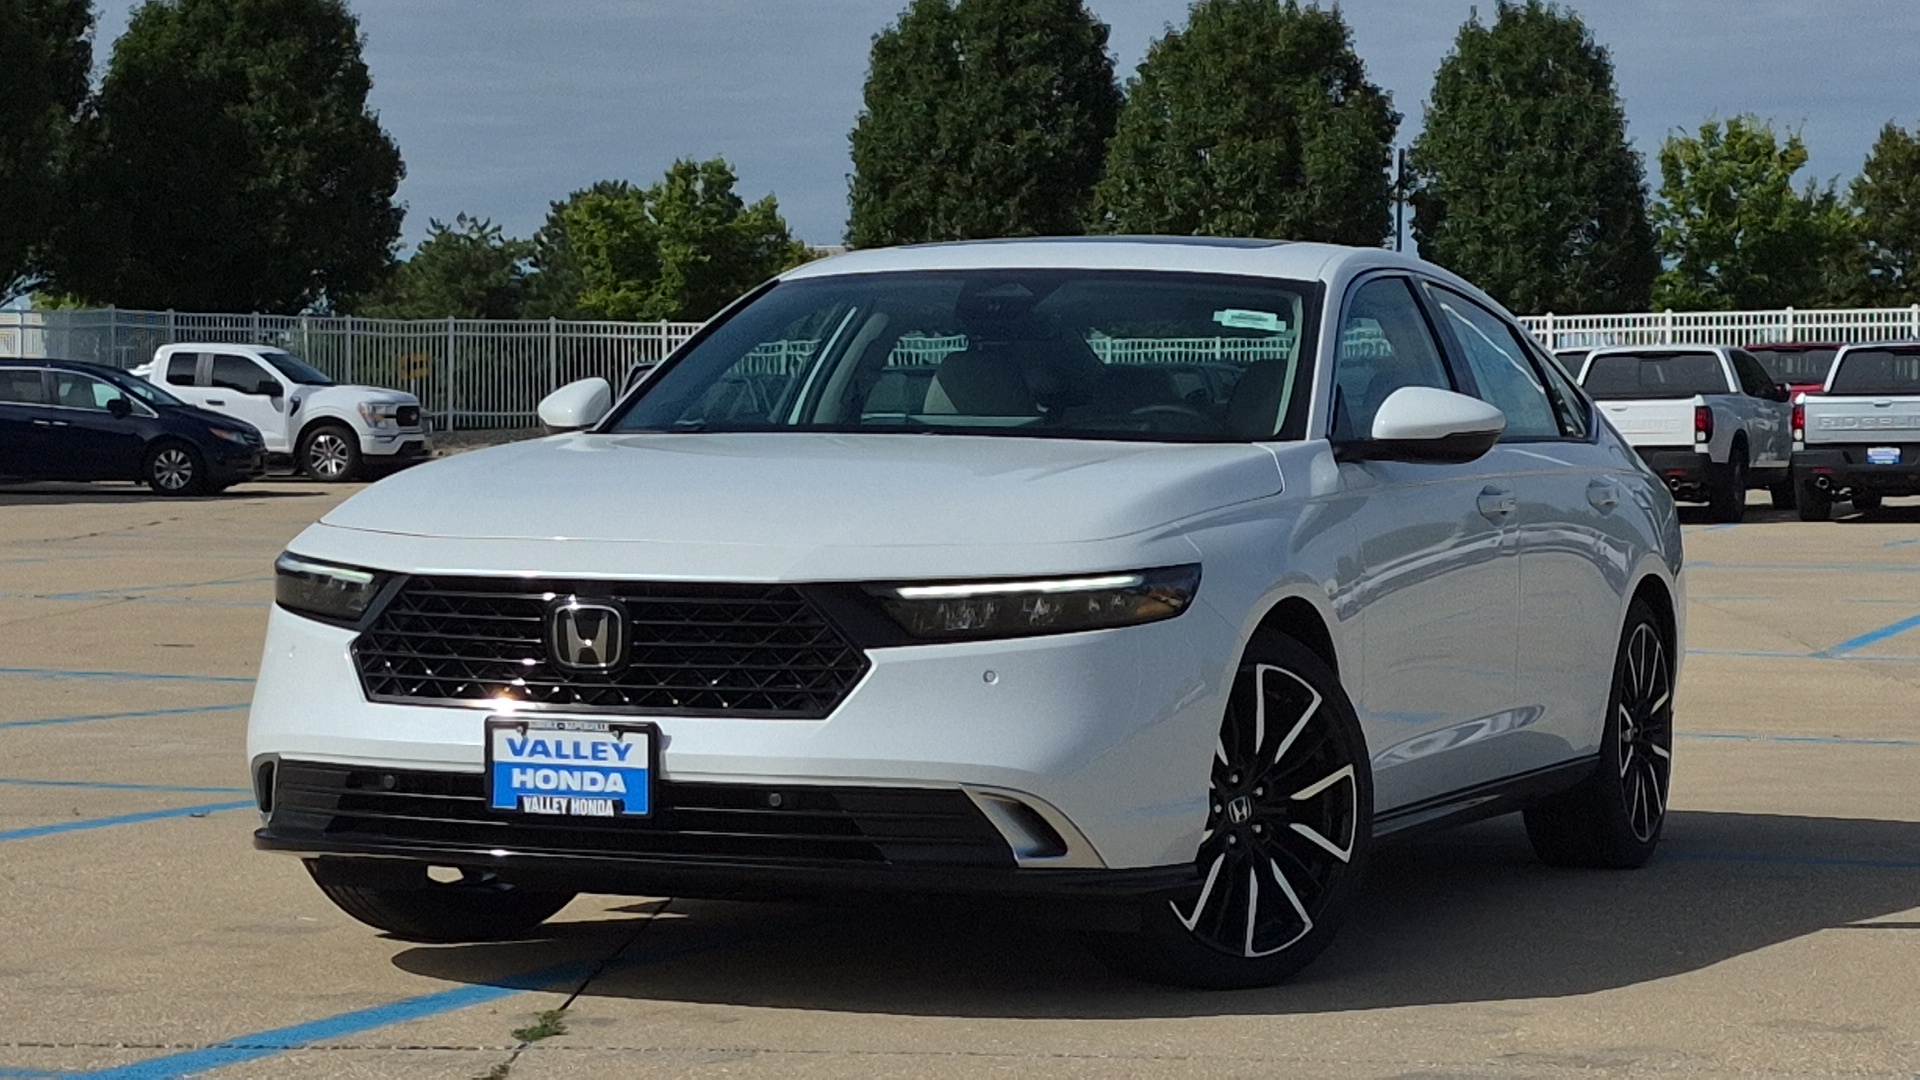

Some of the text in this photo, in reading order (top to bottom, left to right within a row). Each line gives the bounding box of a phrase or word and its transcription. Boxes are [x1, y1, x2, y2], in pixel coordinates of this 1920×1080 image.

[506, 737, 633, 762] VALLEY
[512, 767, 627, 793] HONDA
[523, 796, 614, 817] VALLEY HONDA
